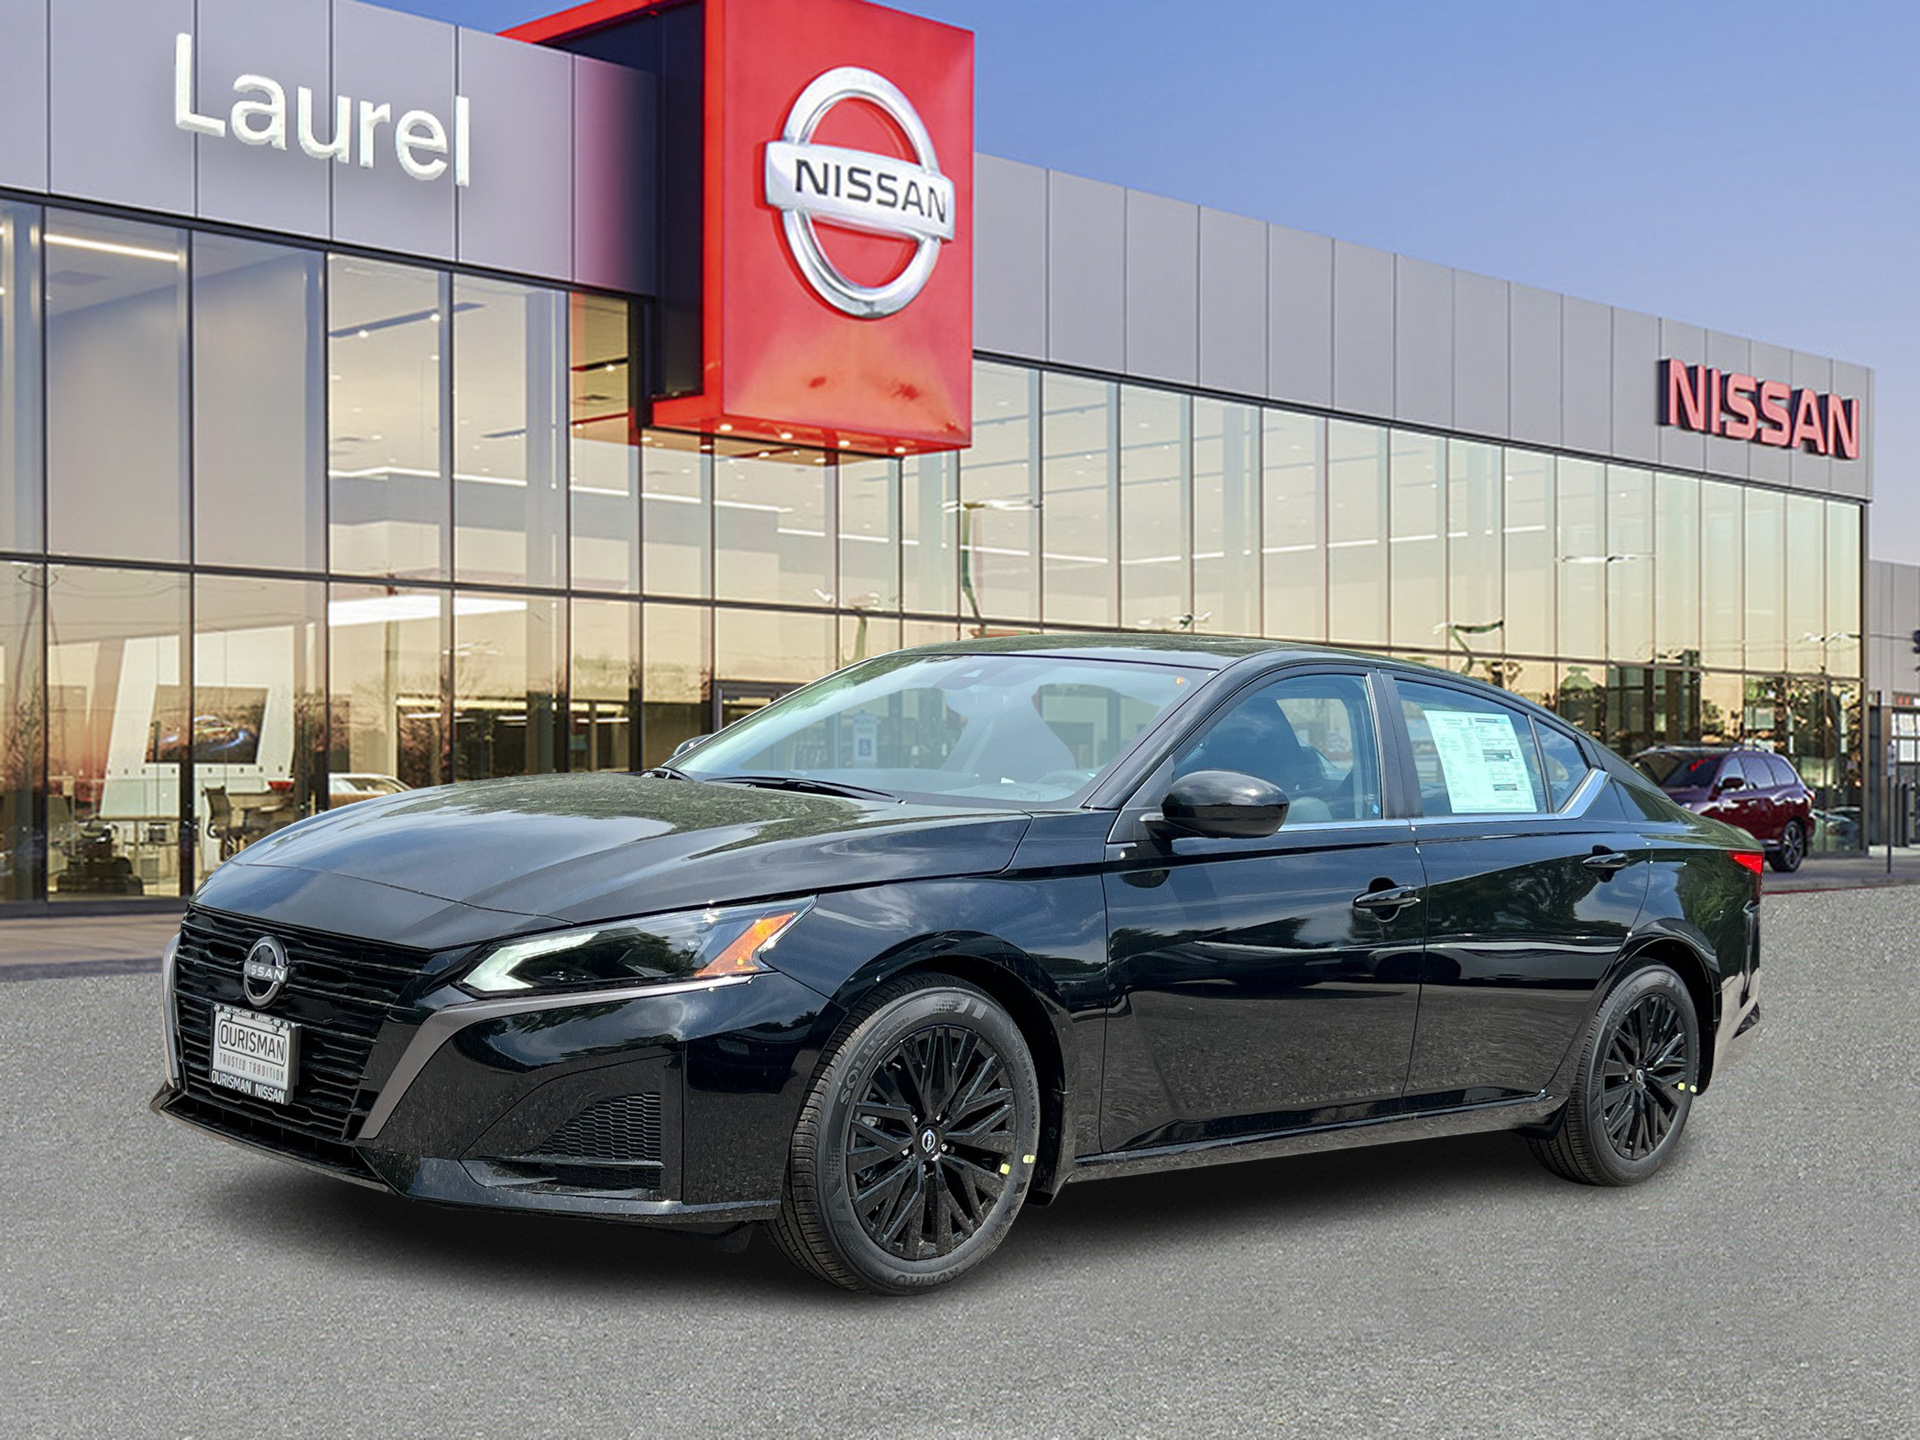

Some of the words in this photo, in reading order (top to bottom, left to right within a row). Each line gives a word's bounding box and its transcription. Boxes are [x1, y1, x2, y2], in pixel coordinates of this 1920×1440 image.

[175, 33, 470, 187] Laurel
[795, 159, 946, 223] NISSAN
[1659, 358, 1860, 460] NISSAN
[219, 1052, 246, 1071] TRUSTED
[249, 1061, 284, 1082] TRADITION
[220, 1023, 285, 1062] OURISMAN
[840, 1027, 889, 1105] SOLUS
[211, 1070, 252, 1095] OURISMAN
[254, 1083, 286, 1104] NISSAN
